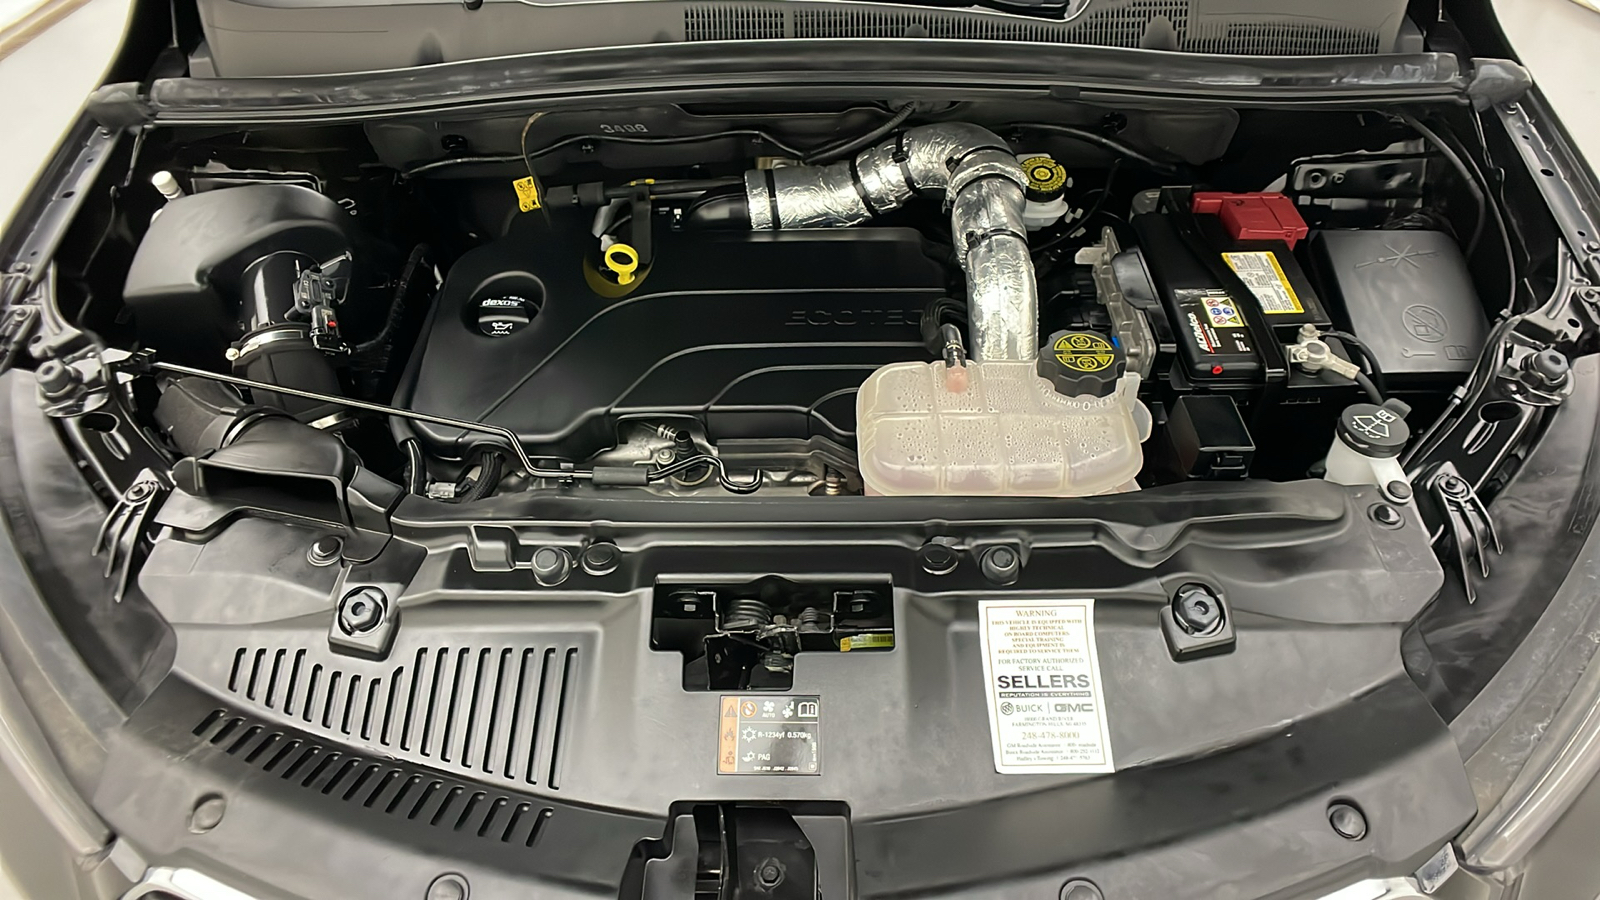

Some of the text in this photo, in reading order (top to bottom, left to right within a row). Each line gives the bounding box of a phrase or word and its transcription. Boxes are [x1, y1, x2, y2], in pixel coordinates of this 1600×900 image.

[482, 298, 518, 306] dexos
[998, 674, 1090, 689] SELLERS
[1016, 703, 1094, 712] BUICK GMC
[1022, 731, 1080, 740] 248-478-8000
